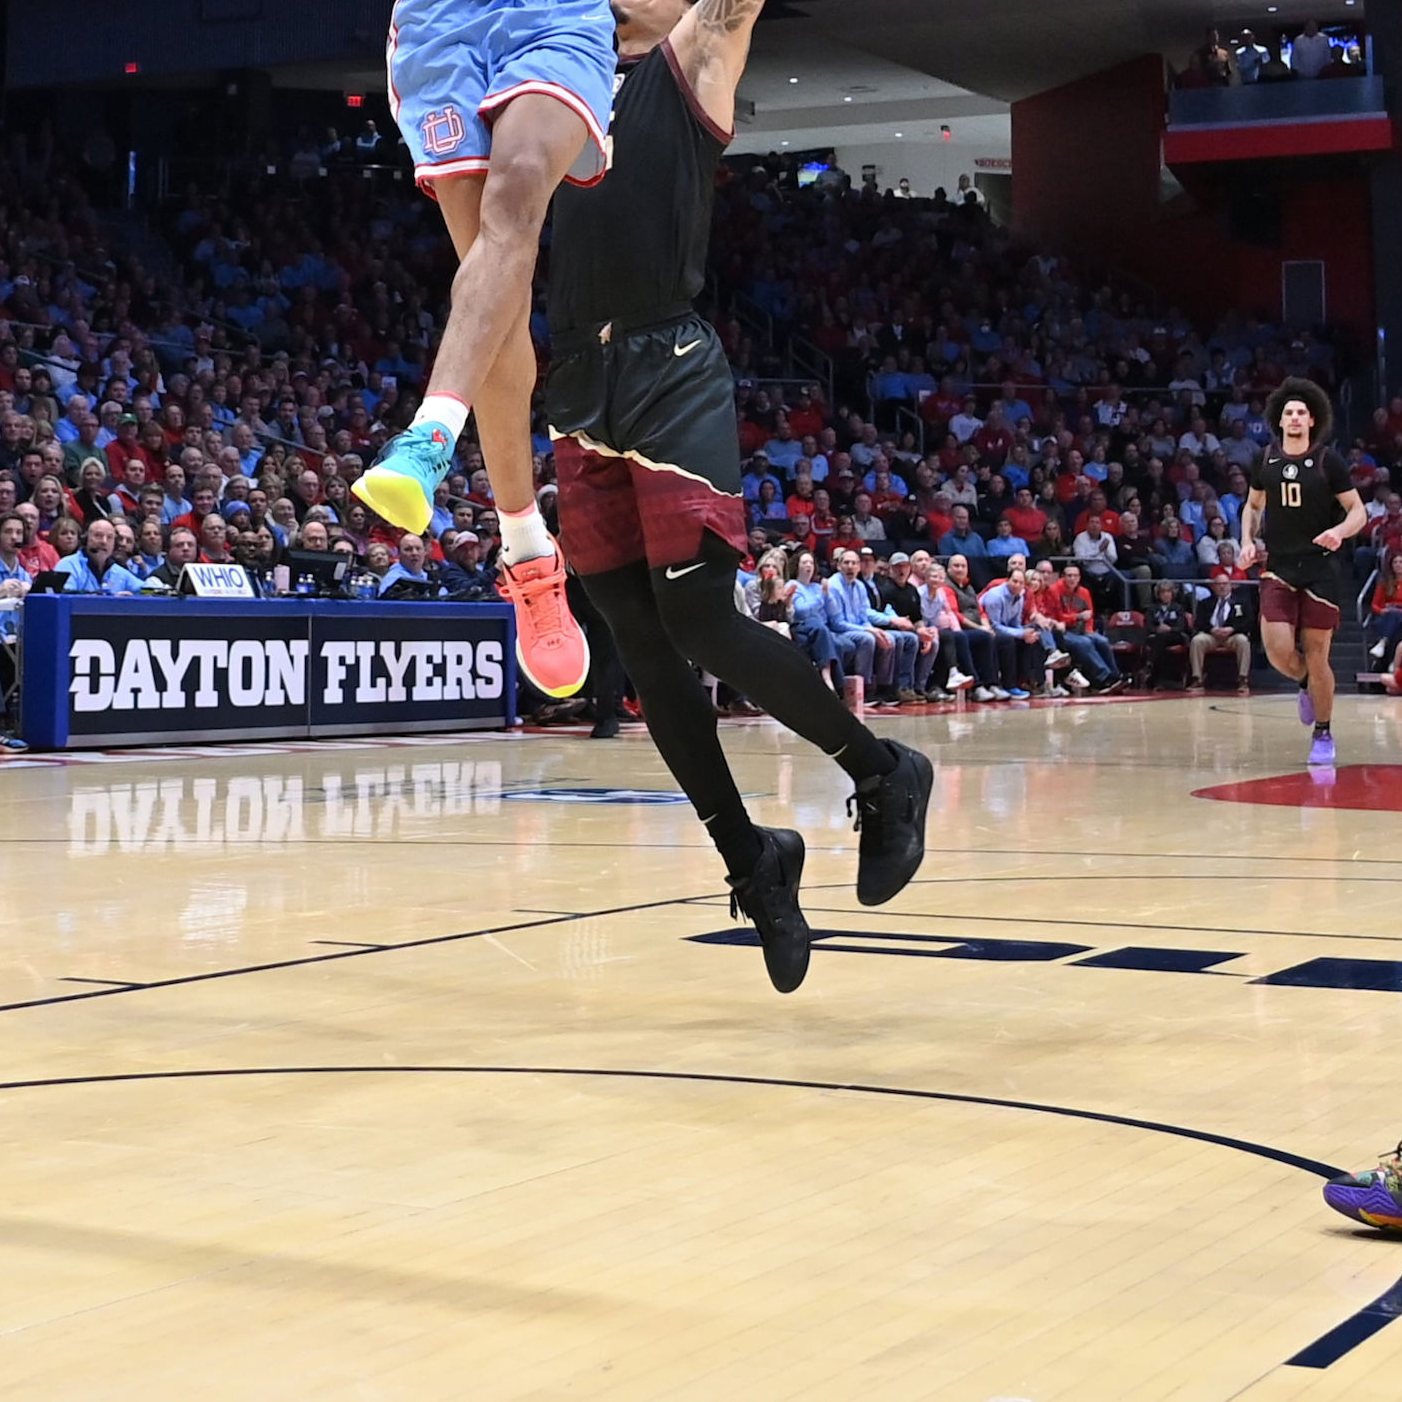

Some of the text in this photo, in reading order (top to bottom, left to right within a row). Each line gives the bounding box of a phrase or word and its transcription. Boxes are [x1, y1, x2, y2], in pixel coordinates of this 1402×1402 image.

[1280, 481, 1302, 508] 10
[192, 567, 244, 588] WHIO
[68, 638, 503, 712] DAYTON FLYERS
